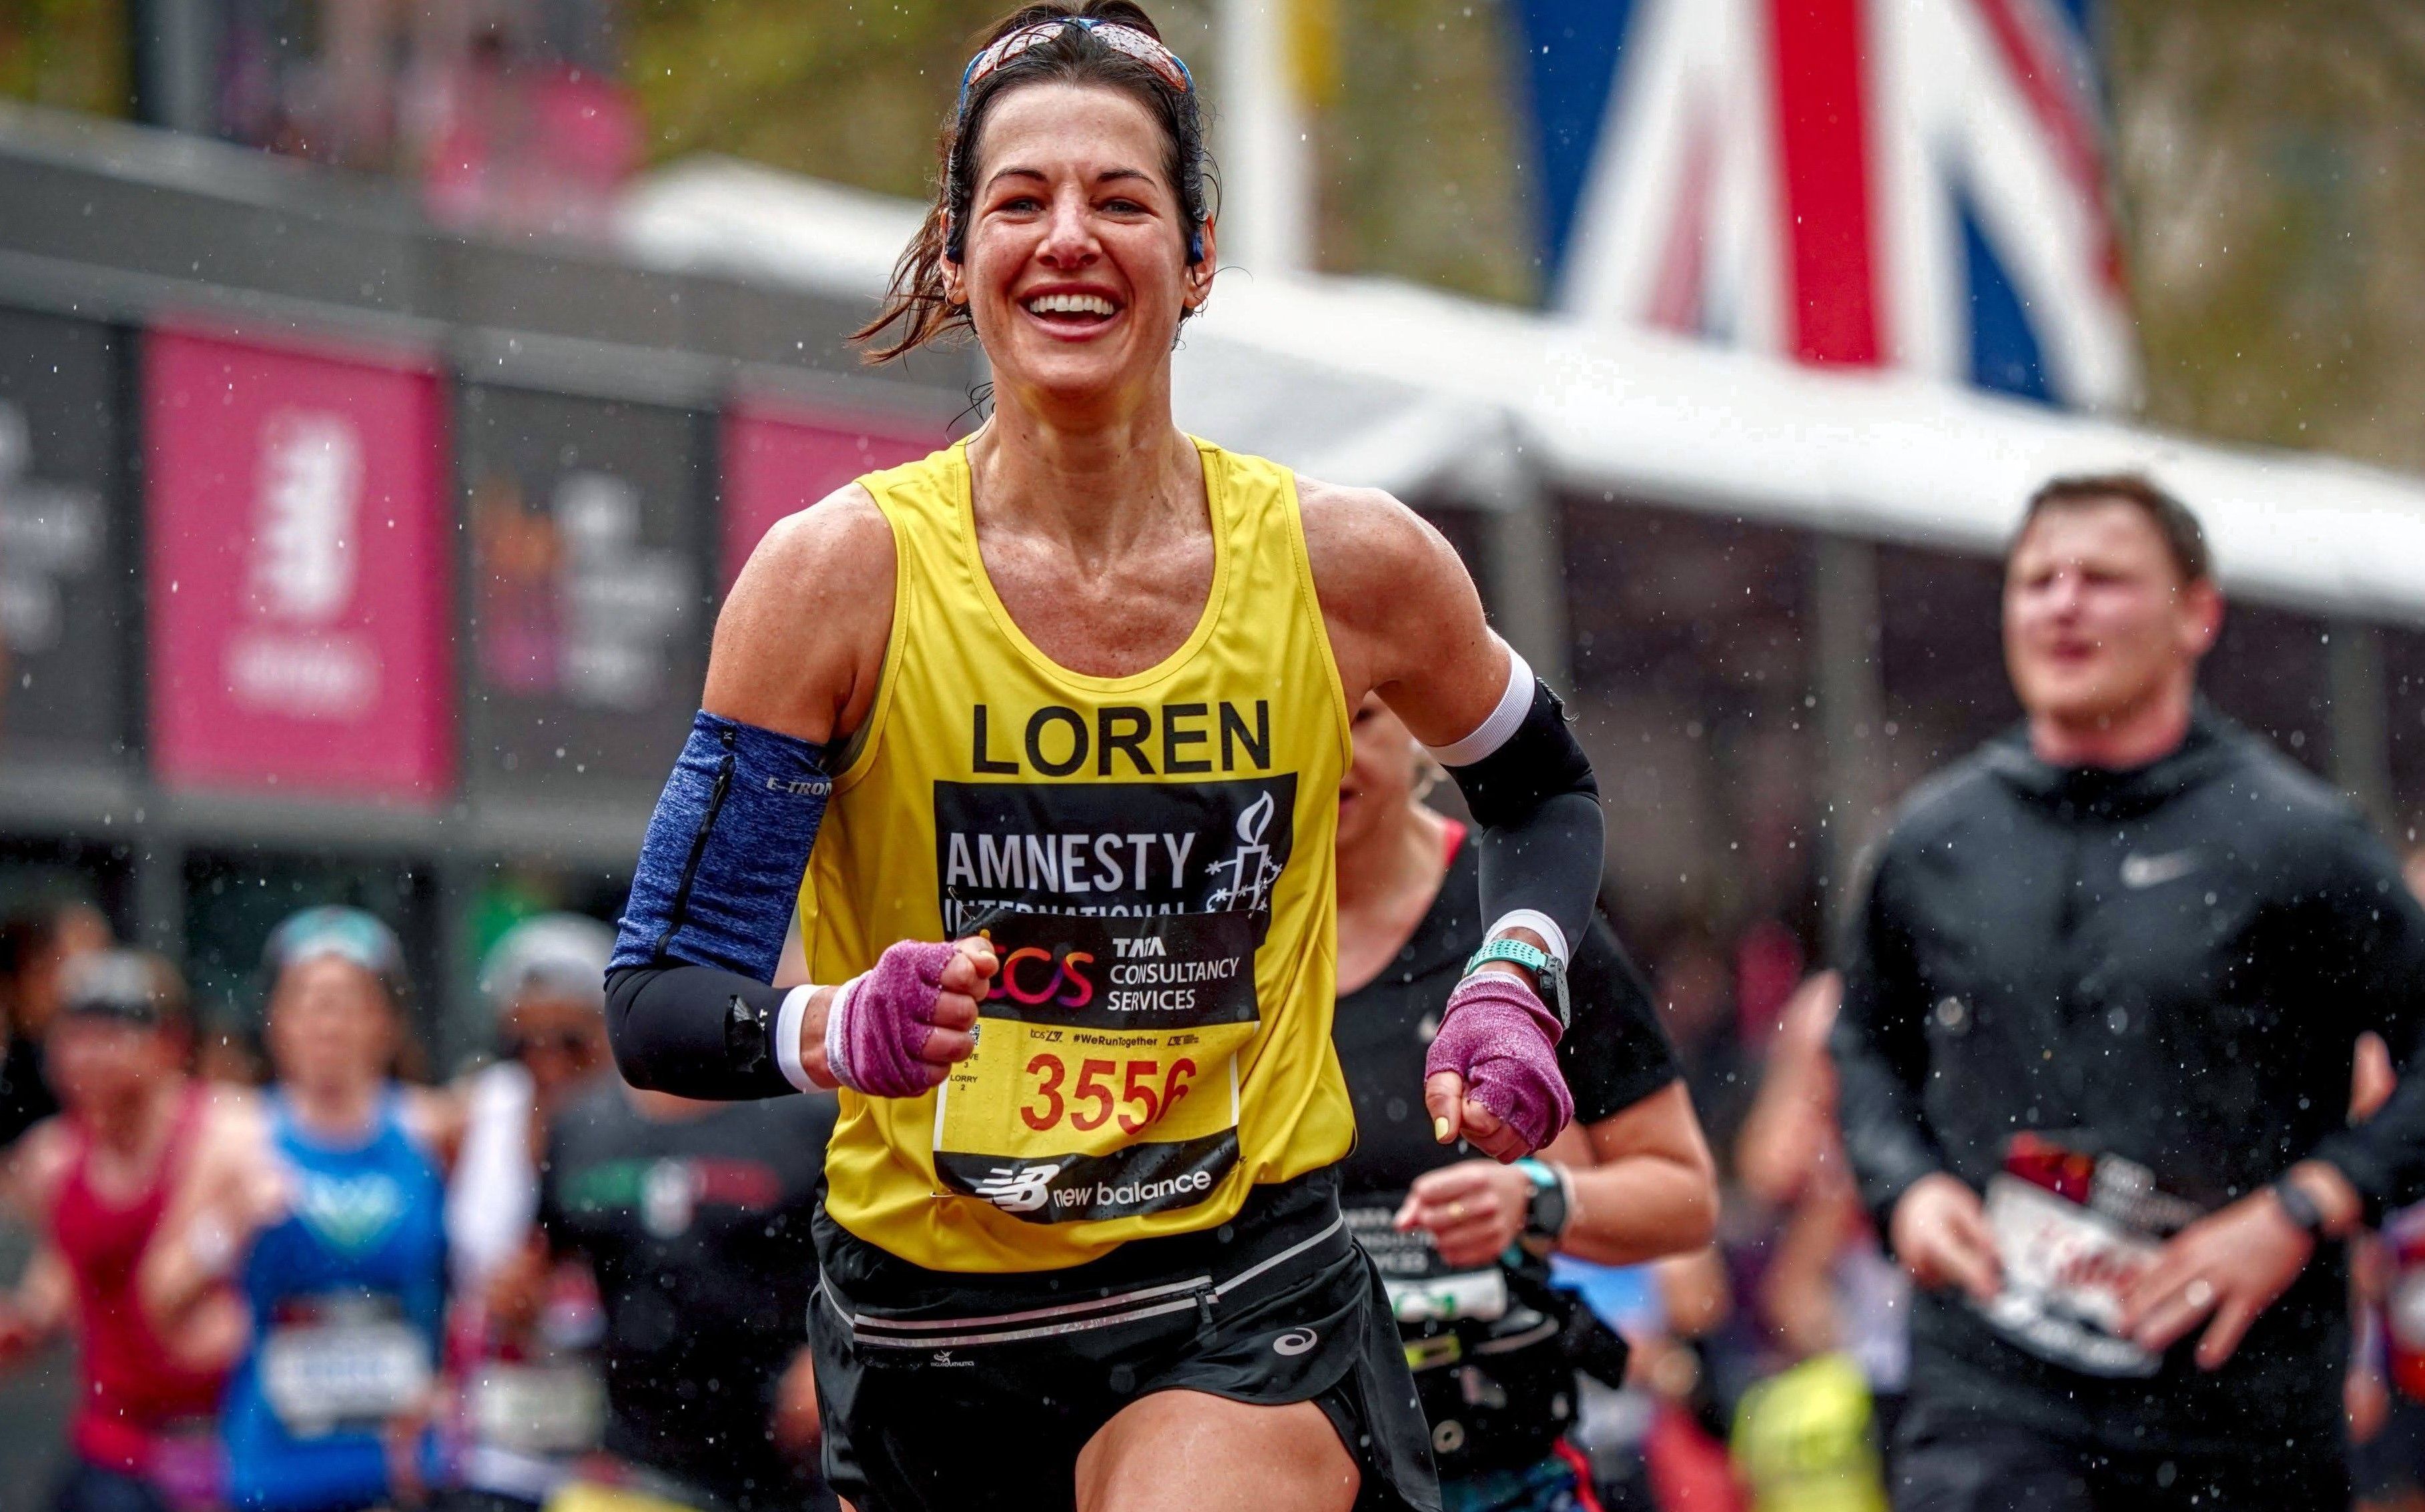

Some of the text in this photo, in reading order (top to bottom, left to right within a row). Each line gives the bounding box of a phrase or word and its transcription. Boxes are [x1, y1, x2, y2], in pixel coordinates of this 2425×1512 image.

[972, 699, 1271, 777] LOREN
[946, 831, 1196, 893] AMNESTY
[1112, 936, 1167, 958] TATA
[1110, 957, 1241, 986] CONSULTANCY
[1106, 989, 1196, 1012] SERVICES
[1073, 1034, 1158, 1048] #WeRunTogether
[950, 1074, 978, 1083] LORRY
[1053, 1170, 1212, 1208] new balance
